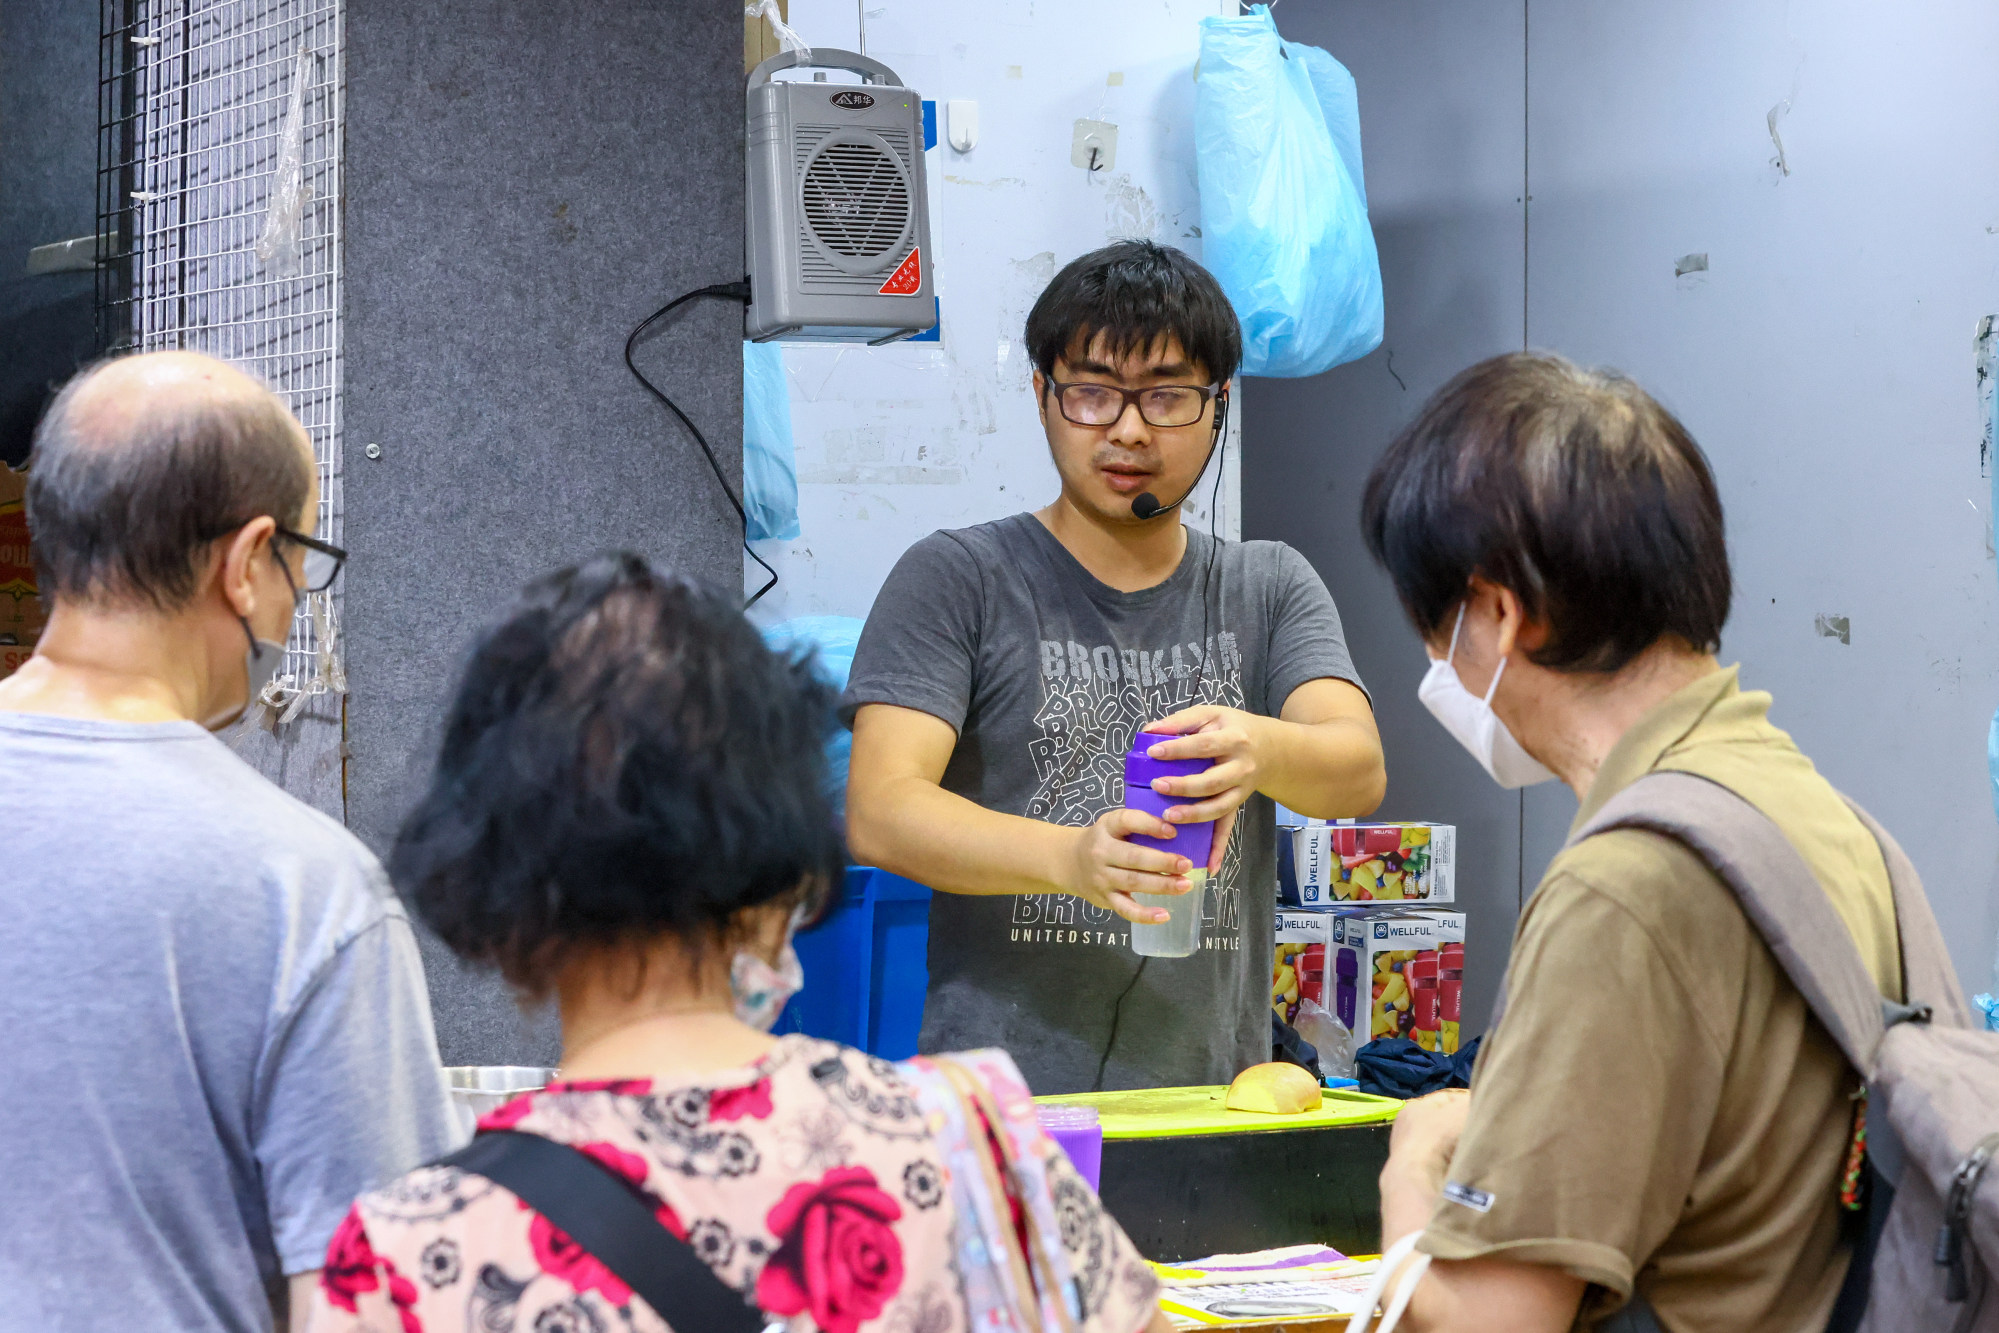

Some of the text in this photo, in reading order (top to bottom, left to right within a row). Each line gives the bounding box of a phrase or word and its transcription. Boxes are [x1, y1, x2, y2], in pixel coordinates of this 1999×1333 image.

[853, 95, 872, 105] 邦华
[1309, 835, 1319, 884] WELLFUL
[1284, 920, 1321, 929] WELLFUL
[1437, 919, 1459, 928] LFUL
[1389, 926, 1432, 936] WELLFUL
